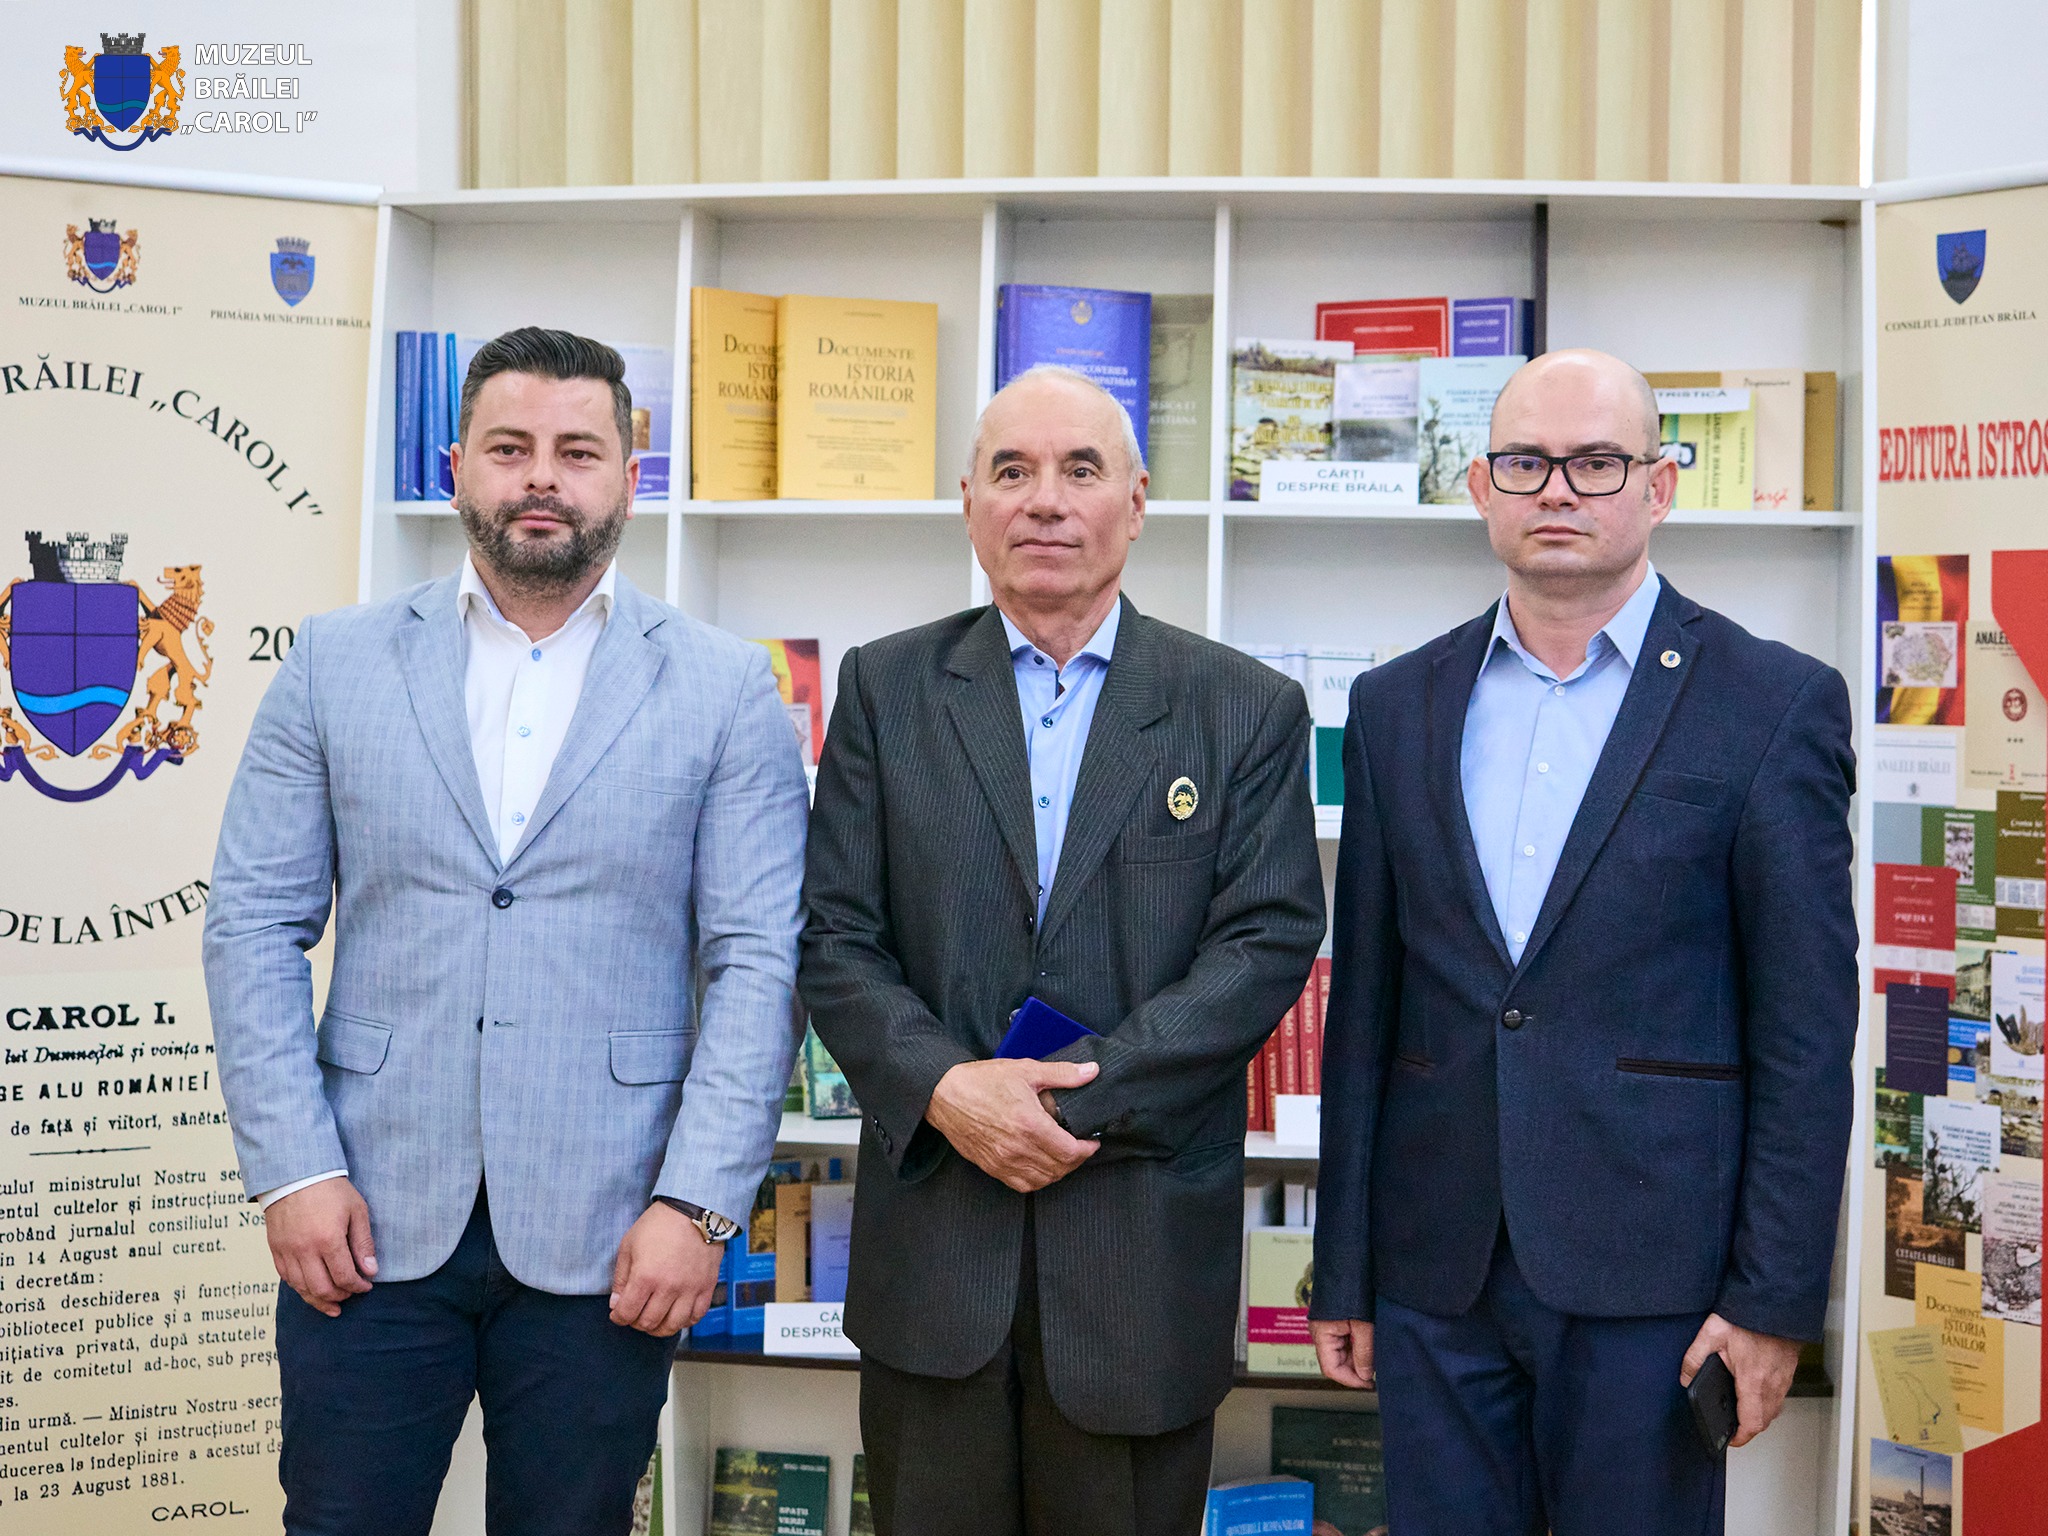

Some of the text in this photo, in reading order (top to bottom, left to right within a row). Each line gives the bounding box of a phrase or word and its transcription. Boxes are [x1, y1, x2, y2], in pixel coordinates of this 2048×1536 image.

[19, 296, 71, 309] MUZEUL
[210, 309, 261, 322] PRIMĂRIA
[263, 313, 333, 327] MUNICIPIULUI
[1885, 318, 1939, 332] CONSILIUL
[0, 353, 145, 400] RĂILEI
[847, 363, 915, 383] ISTORIA
[1878, 424, 1971, 481] EDITURA
[1317, 468, 1365, 480] CĂRȚI
[1276, 481, 1404, 493] DESPRE BRĂILA
[51, 916, 103, 944] LA
[6, 1002, 176, 1031] CAROL I.
[39, 1081, 84, 1099] ALU
[11, 1121, 30, 1136] de
[41, 1118, 73, 1137] față
[83, 1116, 97, 1137] și
[154, 1170, 207, 1186] Nostru
[53, 1198, 119, 1216] cultelor
[128, 1195, 141, 1216] și
[68, 1219, 135, 1243] jurnalul
[28, 1251, 46, 1265] 14
[59, 1245, 118, 1265] August
[128, 1241, 162, 1257] anul
[173, 1238, 226, 1255] curent.
[61, 1289, 160, 1309] deschiderea
[174, 1285, 186, 1305] și
[95, 1312, 154, 1334] publice
[164, 1308, 176, 1328] și
[183, 1311, 192, 1323] a
[781, 1327, 842, 1338] DESPRE
[76, 1337, 140, 1359] privată,
[150, 1332, 188, 1350] după
[198, 1325, 266, 1345] statutele
[23, 1367, 42, 1383] de
[53, 1359, 132, 1380] comitetul
[144, 1355, 201, 1371] ad-hoc,
[207, 1351, 234, 1366] sub
[28, 1411, 77, 1429] urmă.
[109, 1403, 177, 1421] Ministru
[186, 1398, 238, 1414] Nostru
[247, 1395, 282, 1409] secr
[60, 1431, 125, 1450] cultelor
[134, 1427, 147, 1447] și
[0, 1462, 65, 1479] ducerea
[71, 1457, 84, 1472] la
[189, 1449, 197, 1460] a
[14, 1471, 184, 1501] la 23 August 1881.
[151, 1501, 249, 1522] CAROL.
